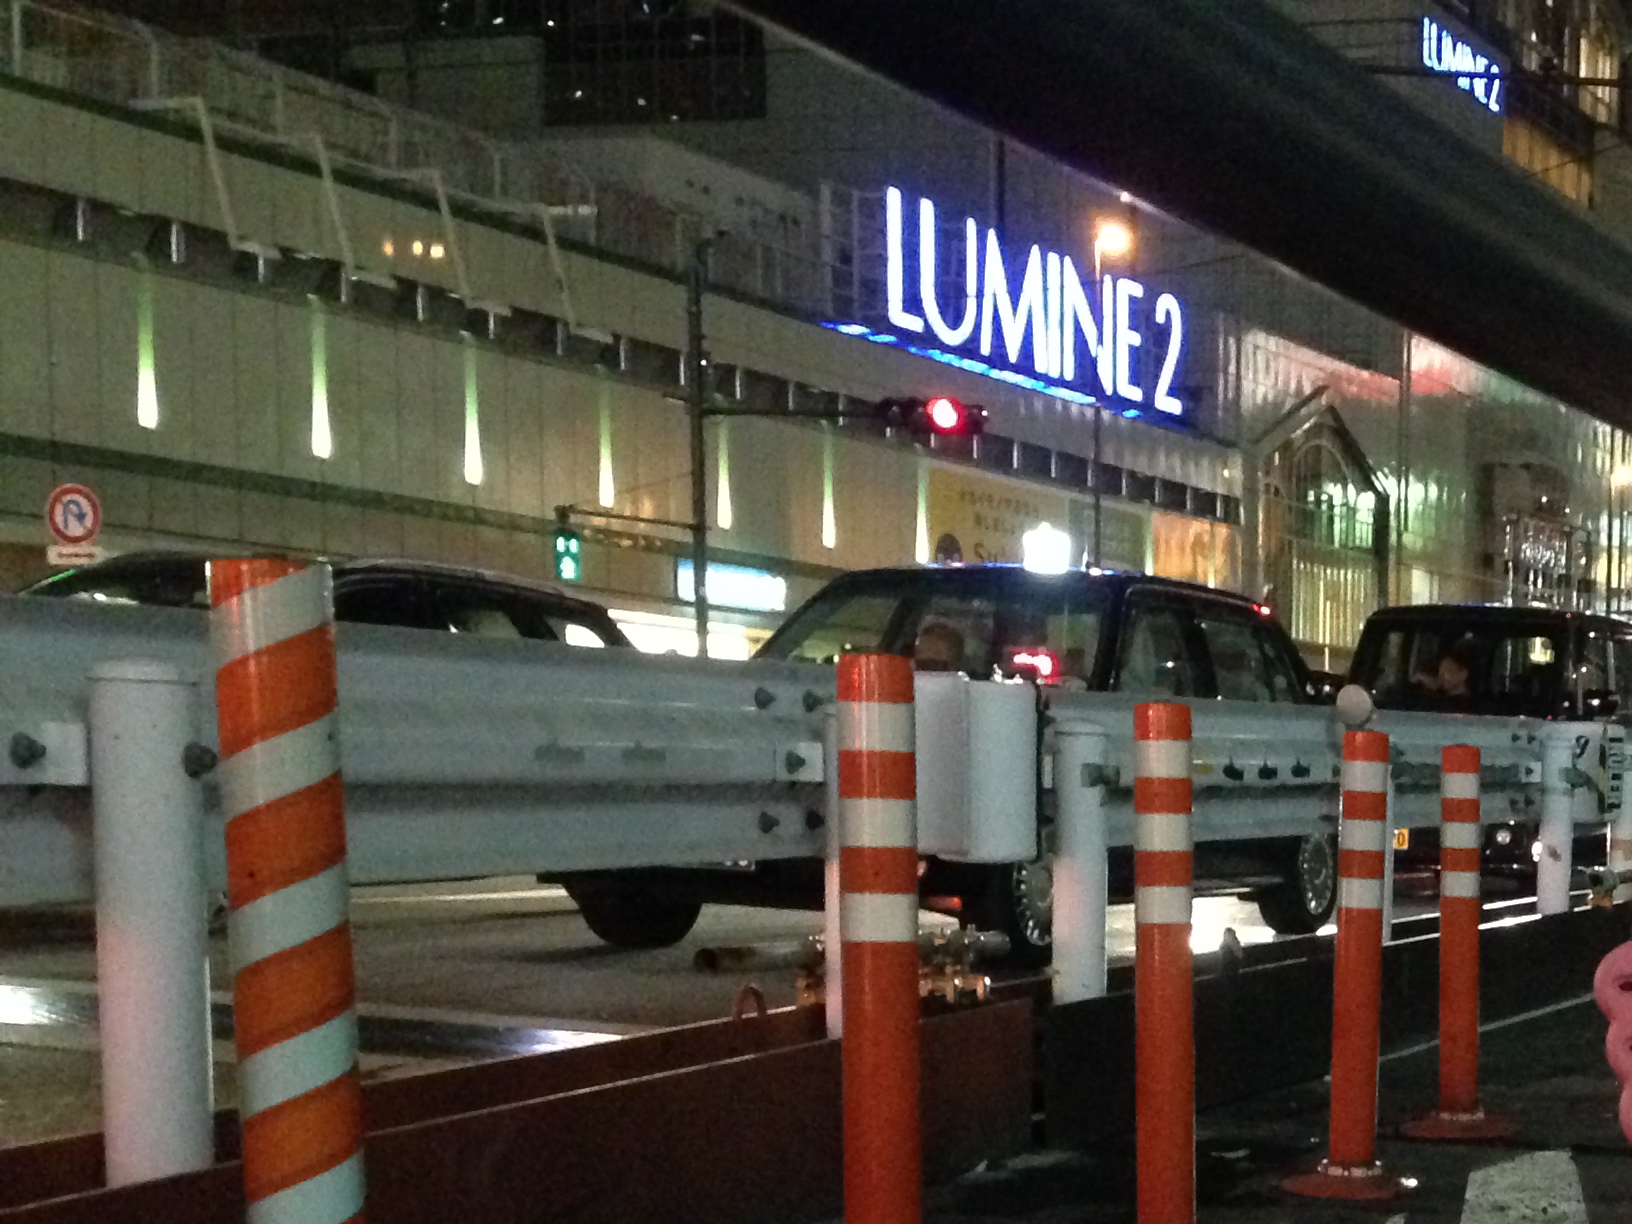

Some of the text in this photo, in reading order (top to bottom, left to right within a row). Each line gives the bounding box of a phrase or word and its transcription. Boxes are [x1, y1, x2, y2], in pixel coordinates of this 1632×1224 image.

[1423, 17, 1500, 112] LUMINE 2
[886, 186, 1184, 416] LUMINE 2
